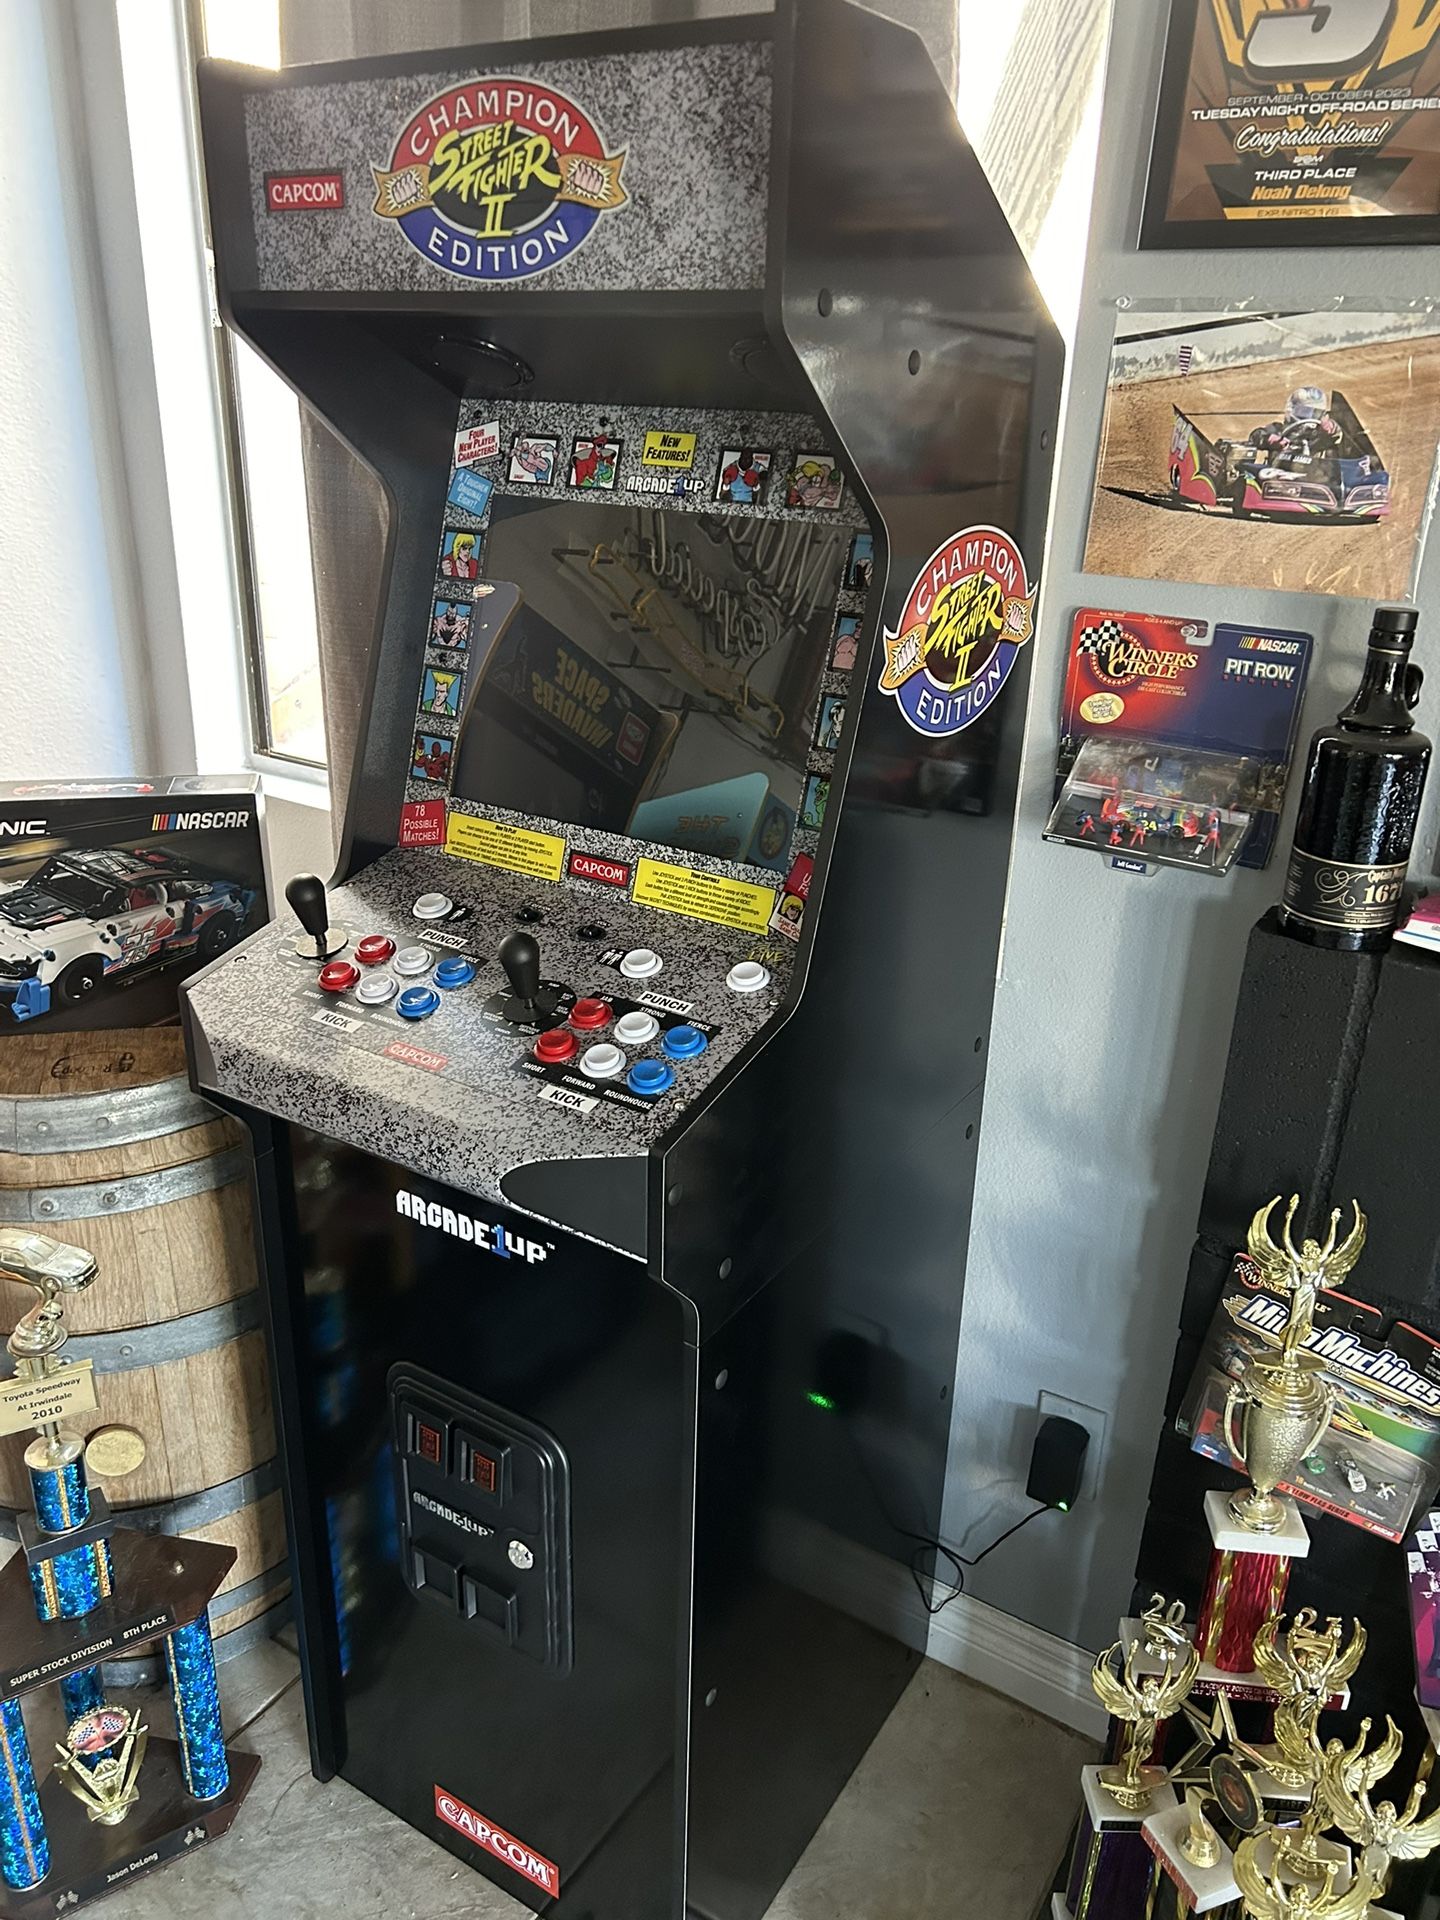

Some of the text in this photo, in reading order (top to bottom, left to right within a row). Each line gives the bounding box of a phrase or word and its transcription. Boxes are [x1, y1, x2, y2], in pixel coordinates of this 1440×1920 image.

[1227, 93, 1304, 107] SEPTEMBER
[1310, 90, 1373, 103] OCTOBER
[1374, 87, 1413, 99] 2023
[1191, 97, 1440, 121] TUESDAY NIGHT OFF-ROAD SERIE
[410, 89, 580, 157] CHAMPION
[1236, 121, 1386, 155] Congratulations!
[427, 119, 515, 196] STREET
[445, 134, 562, 203] FIGHTER
[1254, 167, 1358, 181] THIRD PLACE
[272, 182, 339, 204] CAPCOM
[1251, 184, 1352, 201] Noah Delong
[475, 192, 518, 240] II
[428, 219, 570, 273] EDITION
[915, 540, 1018, 616] CHAMPION
[924, 569, 986, 658] STREET
[935, 582, 1004, 659] FIGHTER
[1101, 640, 1199, 669] WINNER'S
[1257, 638, 1299, 655] NASCAR
[949, 641, 980, 692] II
[1107, 658, 1180, 679] CIRCLE
[1224, 658, 1296, 681] PIT ROW
[915, 658, 1002, 725] EDITION
[175, 811, 250, 830] NASCAR
[415, 804, 426, 817] 78
[573, 858, 624, 881] CAPCOM
[422, 930, 465, 948] PUNCH
[458, 953, 481, 964] FIERCE
[639, 1006, 667, 1019] STRONG
[641, 992, 690, 1013] PUNCH
[321, 1012, 353, 1029] KICK
[686, 1019, 713, 1032] FIERCE
[389, 1044, 442, 1067] CAPCOM
[521, 1061, 546, 1074] SHORT
[561, 1074, 596, 1091] FORWARD
[550, 1089, 586, 1109] KICK
[603, 1088, 654, 1110] ROUNDHOUSE
[1312, 1330, 1440, 1406] Machines
[3, 1377, 81, 1403] Toyota Speedway
[17, 1392, 73, 1412] At Irwindale
[31, 1405, 63, 1421] 2010
[10, 1614, 168, 1687] SUPER STOCK DIVISION 8TH PLACE
[438, 1795, 551, 1889] CAPCOM
[106, 1852, 159, 1884] Jason DeLong
